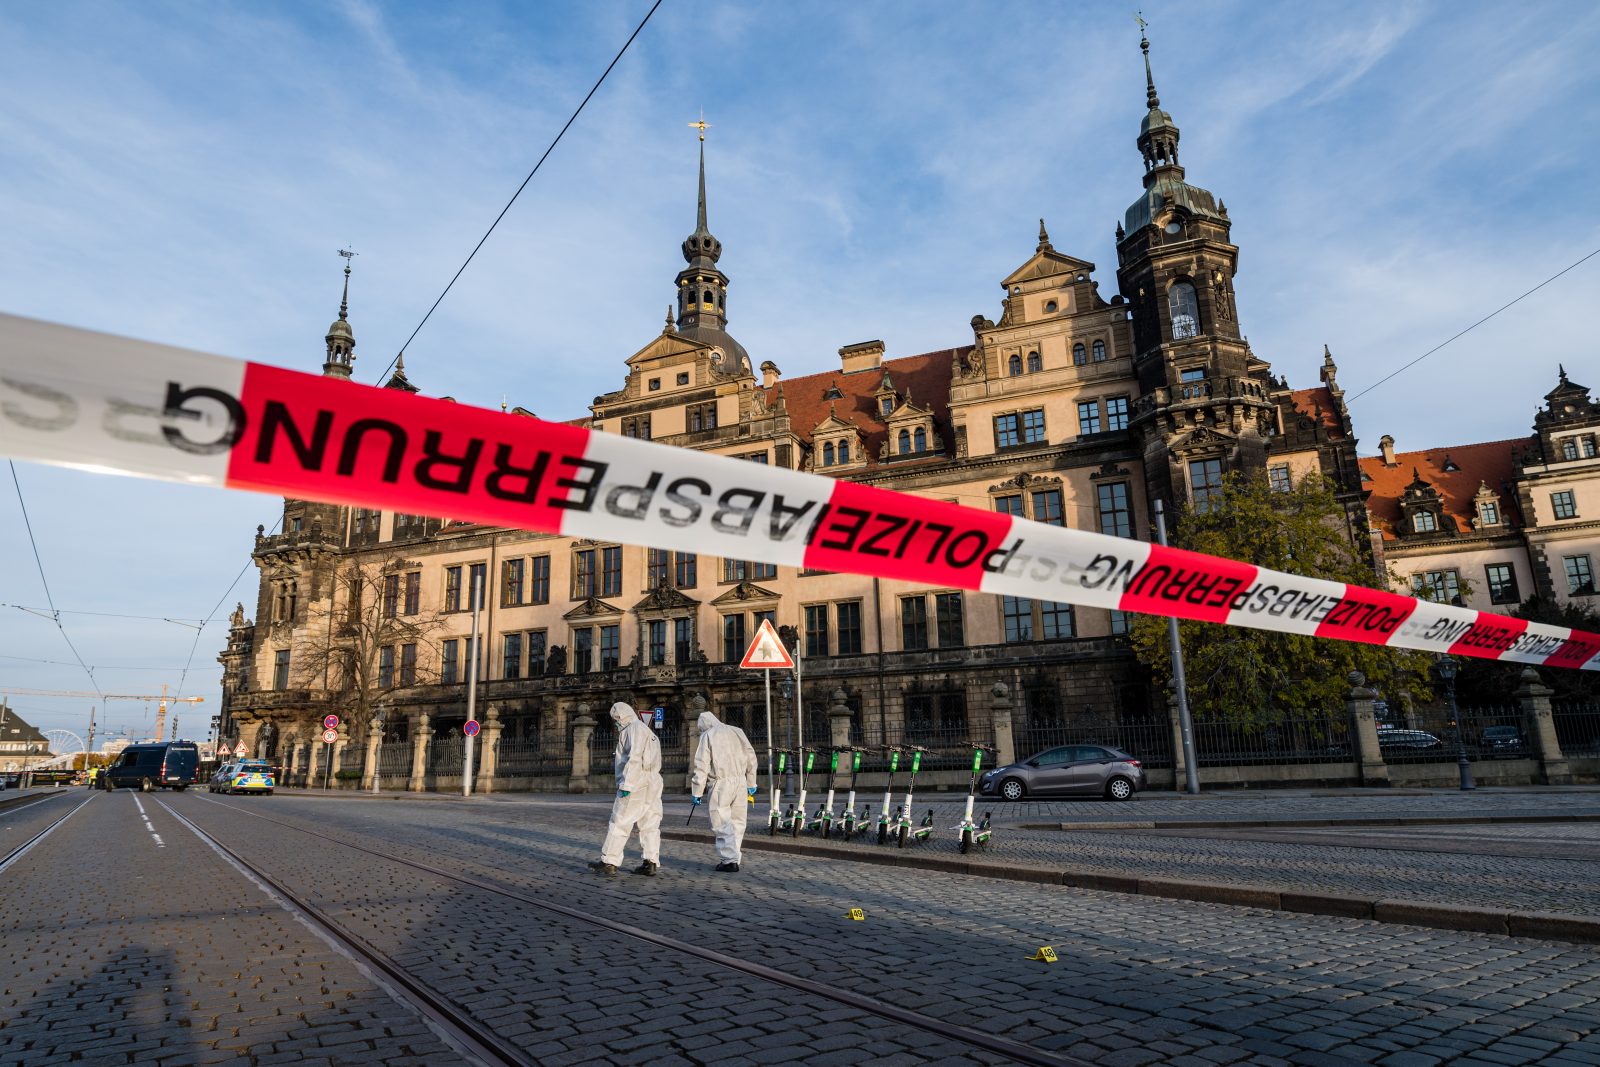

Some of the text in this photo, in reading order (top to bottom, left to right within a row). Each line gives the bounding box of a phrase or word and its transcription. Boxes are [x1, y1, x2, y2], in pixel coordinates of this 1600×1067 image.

[161, 380, 1024, 574] POLIZEIABSPERRUNG
[1080, 553, 1408, 633] POLIZEIABSPERRUNG
[853, 909, 862, 918] 49
